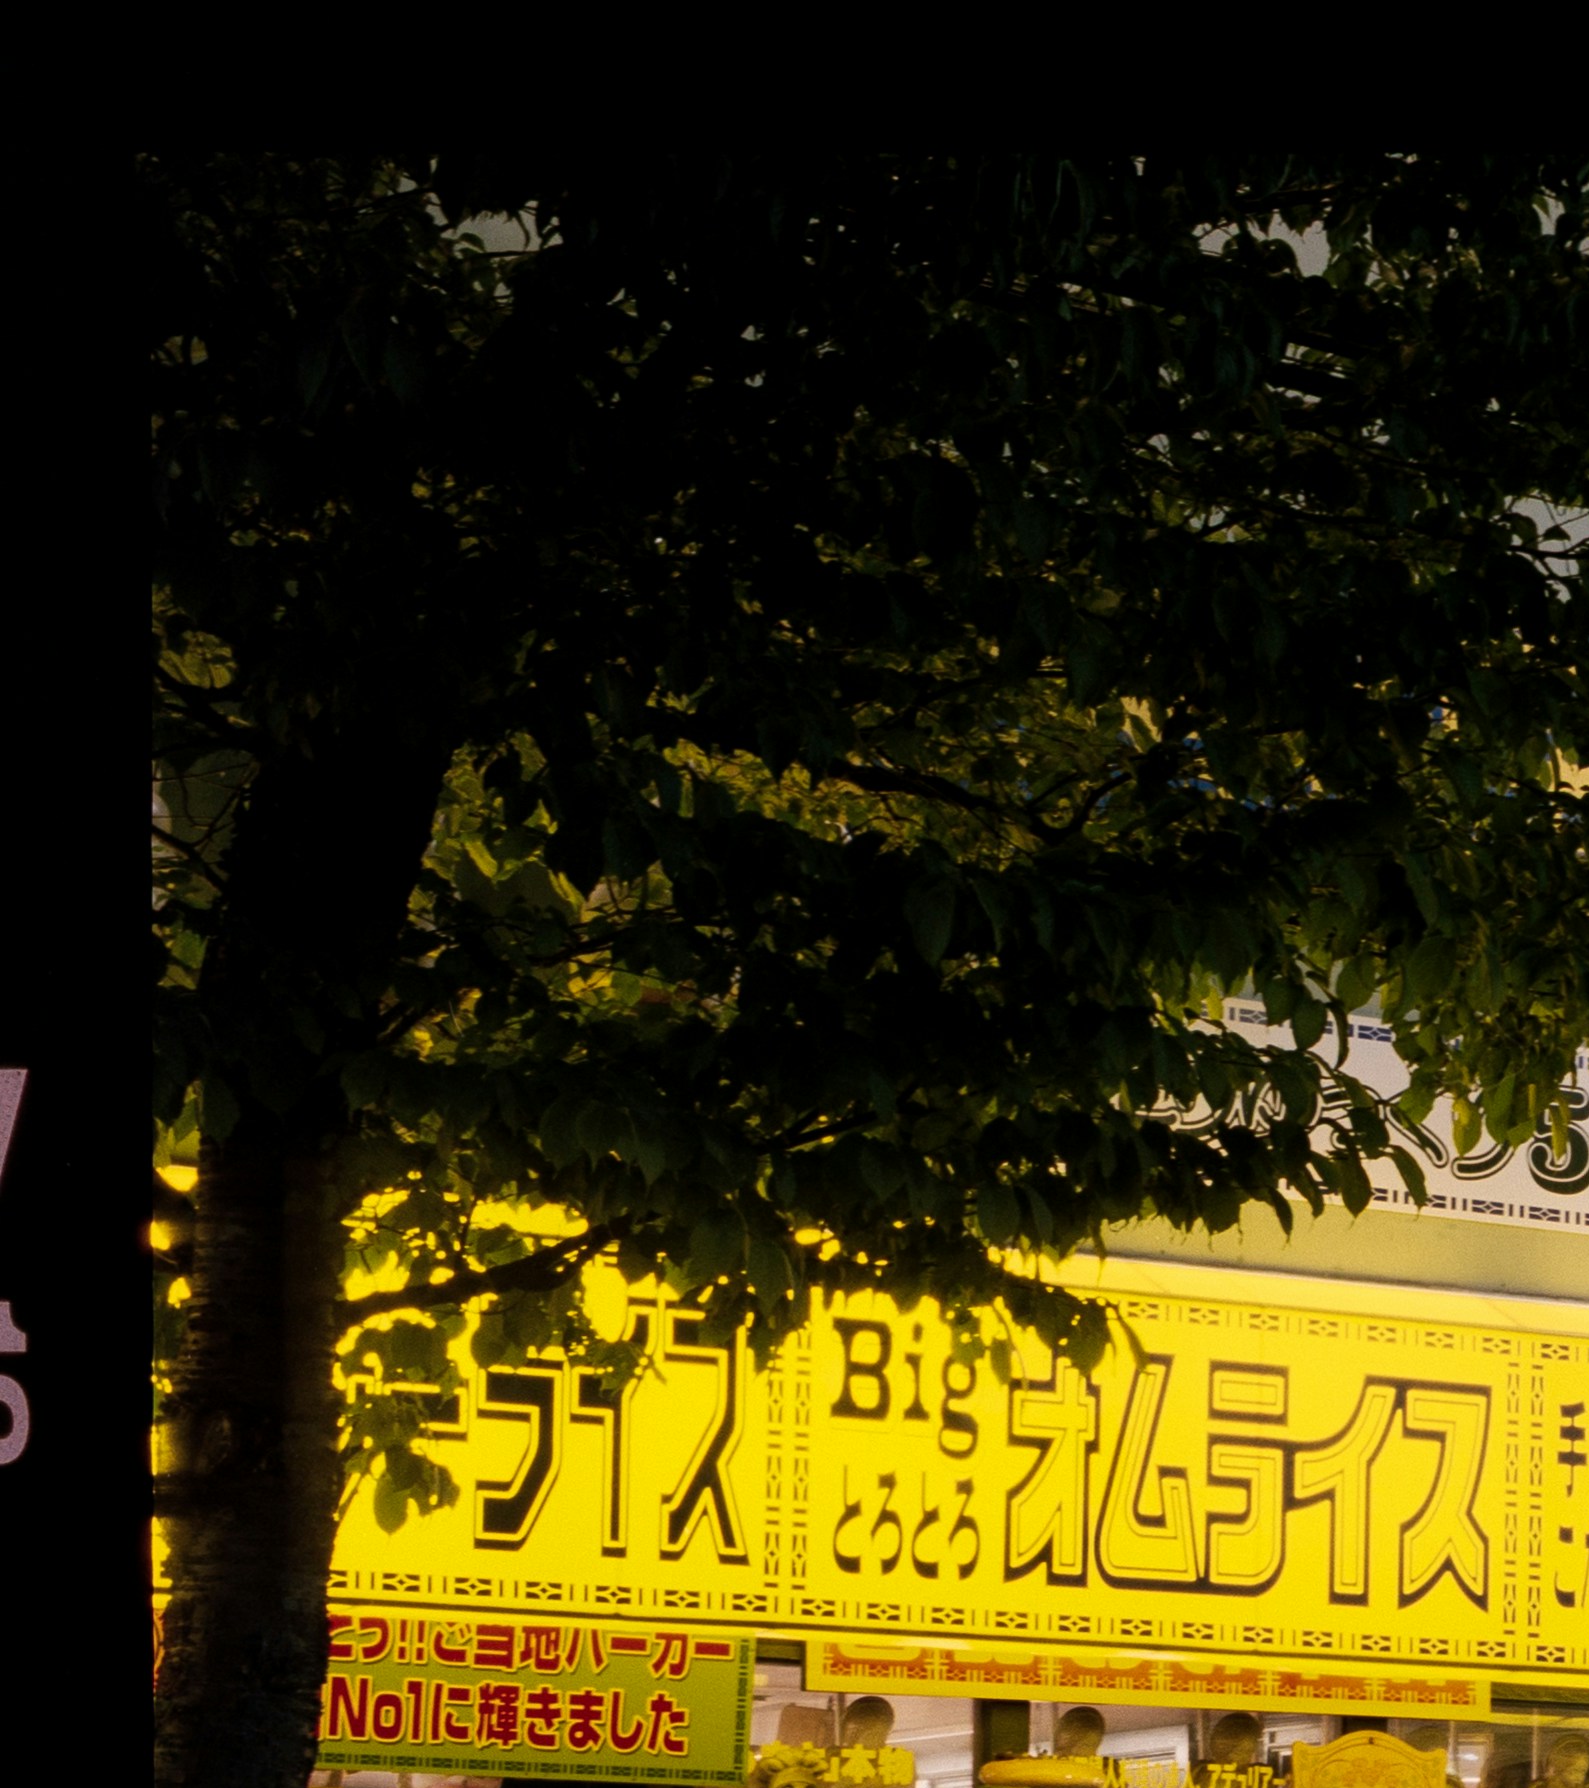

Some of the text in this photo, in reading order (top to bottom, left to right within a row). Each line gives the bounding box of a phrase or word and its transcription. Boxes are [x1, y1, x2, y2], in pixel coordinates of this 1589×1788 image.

[831, 1316, 979, 1460] Big
[832, 1463, 981, 1581] とろとろ
[1003, 1350, 1492, 1615] オムライス
[316, 1677, 690, 1758] No1に輝きました
